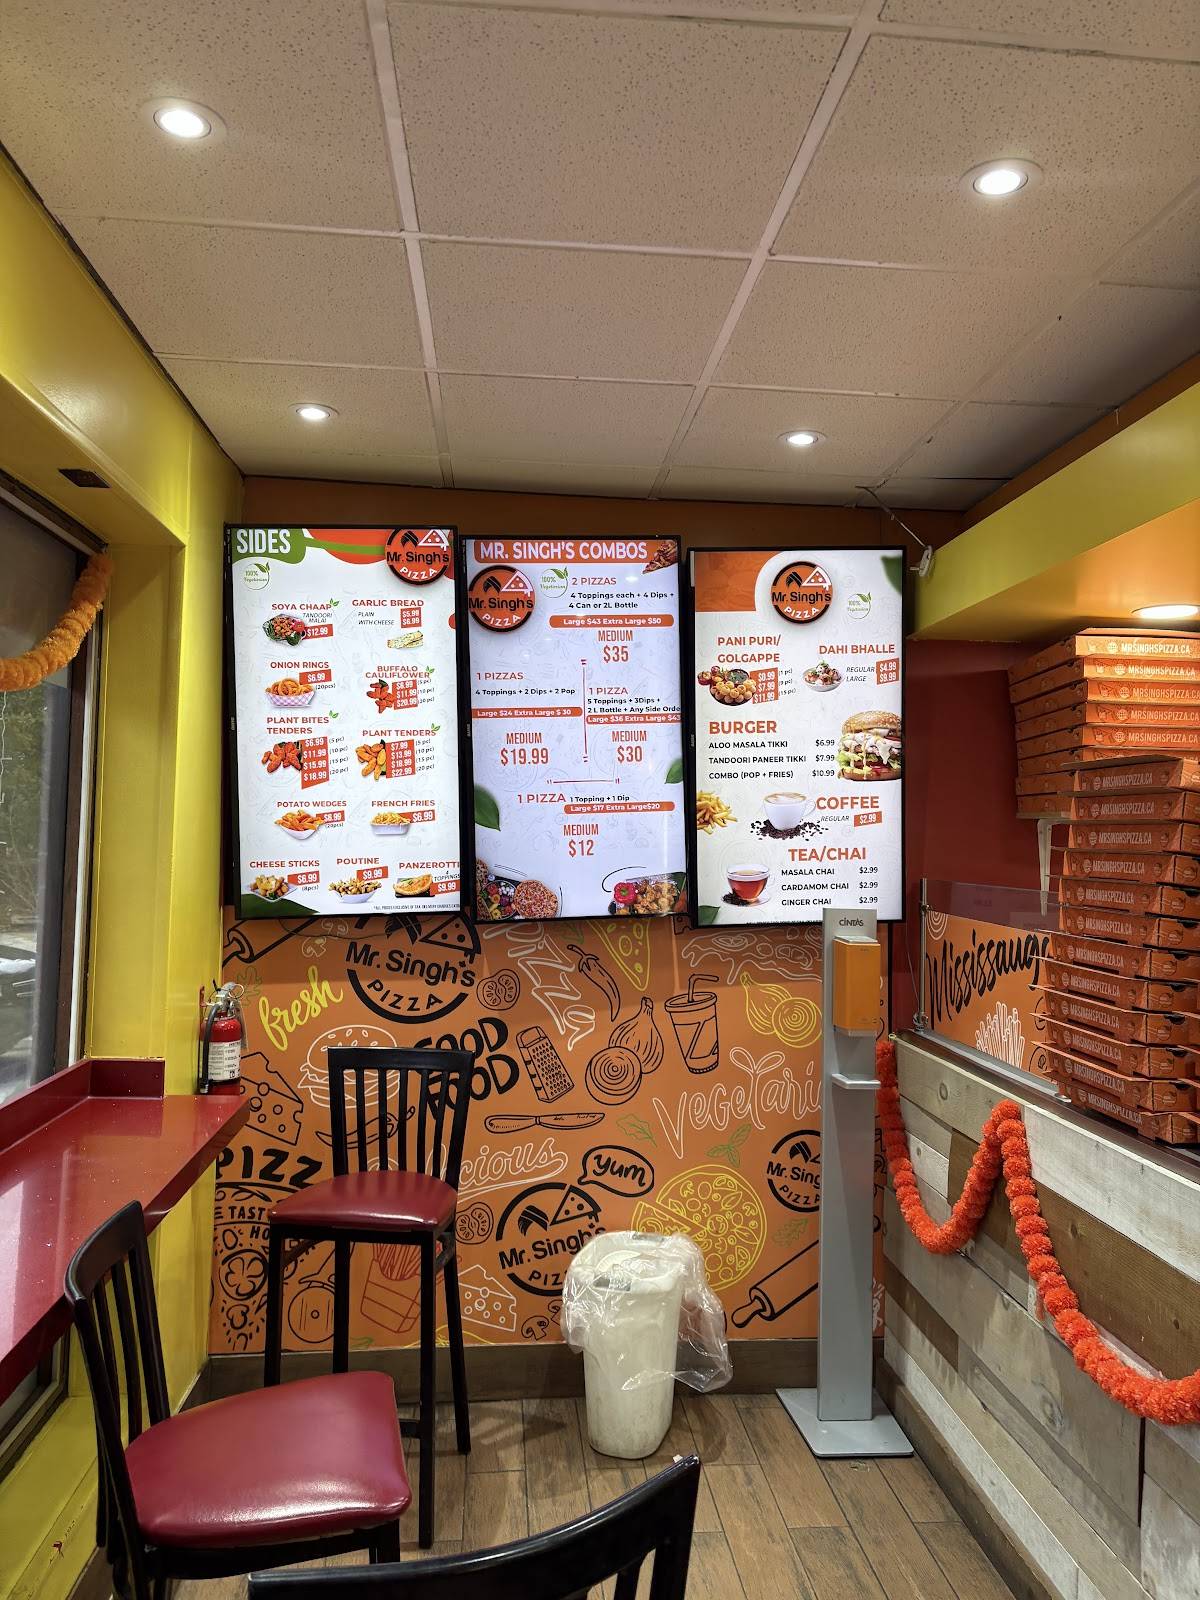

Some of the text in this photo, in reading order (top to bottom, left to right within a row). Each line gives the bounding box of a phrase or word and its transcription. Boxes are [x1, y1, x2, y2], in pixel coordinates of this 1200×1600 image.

[236, 529, 291, 553] SIDES
[481, 542, 647, 559] MR. SINGH'S COMBOS
[387, 551, 449, 564] Mr. Singh's
[399, 567, 437, 579] PIZZA
[580, 577, 616, 585] PIZZAS
[352, 599, 387, 607] GARLIC
[772, 592, 831, 604] Mr. Singh's
[469, 598, 533, 611] Mr. Singh's
[784, 607, 819, 618] PIZZA
[482, 614, 521, 626] PIZZA
[564, 618, 585, 626] Large
[648, 617, 661, 625] $50
[307, 627, 328, 636] $12.99
[598, 631, 633, 641] MEDIUM
[718, 635, 781, 645] PANI PURI/
[819, 645, 895, 654] DAHI BHALLE
[1121, 642, 1190, 654] MRSINGHSPIZZA.CA
[604, 645, 629, 663] $35
[718, 654, 780, 663] GOLGAPPE
[270, 661, 329, 669] ONION RINGS
[1128, 666, 1196, 676] MRSINGHSPIZZA.CA
[483, 689, 517, 697] Toppings
[531, 688, 547, 696] Dips
[596, 687, 628, 695] PIZZA
[478, 709, 498, 718] Large
[535, 709, 554, 717] Large
[1130, 711, 1199, 721] MRSINGHSPIZZA.CA
[709, 721, 777, 734] BURGER
[507, 733, 542, 744] MEDIUM
[612, 731, 647, 742] MEDIUM
[1128, 733, 1198, 743] MRSINGHSPIZZA.CA
[815, 739, 835, 747] $6.99
[303, 748, 326, 758] $11.99
[501, 748, 549, 765] $19.99
[617, 746, 643, 764] $30
[741, 771, 760, 780] (POP
[518, 794, 566, 803] 1 PIZZA
[618, 795, 630, 803] Dip
[816, 796, 879, 810] COFFEE
[859, 814, 876, 823] $2.99
[564, 824, 598, 835] MEDIUM
[569, 840, 594, 857] $12
[788, 846, 866, 862] TEA/CHAI
[839, 918, 863, 927] CINTAS
[345, 941, 475, 988] Mr. Singh's
[367, 979, 444, 1011] PIZZA
[258, 965, 344, 1051] fresh
[216, 1146, 322, 1189] PIZZ
[767, 1161, 820, 1189] Mr. Sing
[228, 1206, 266, 1220] TAST
[499, 1248, 530, 1269] Mr.
[528, 1269, 567, 1286] PIZ
